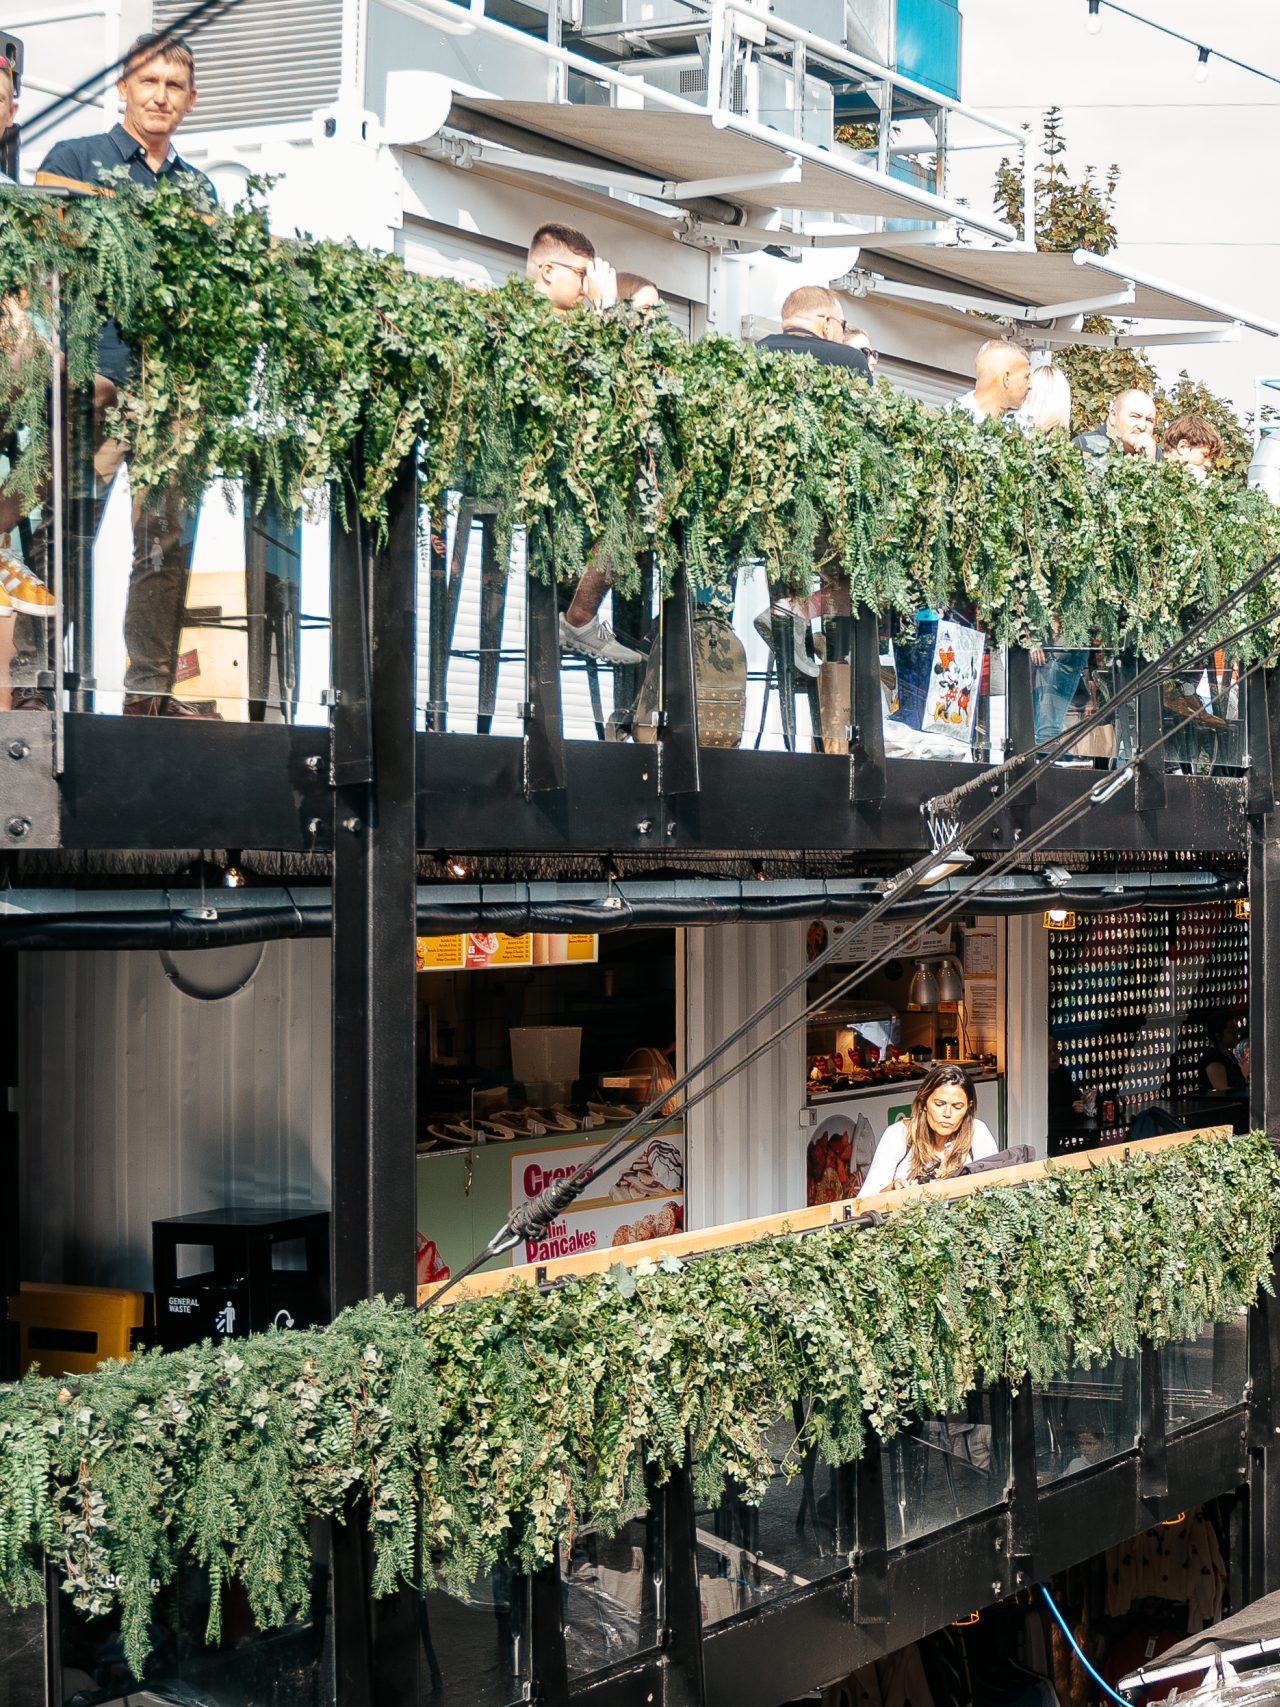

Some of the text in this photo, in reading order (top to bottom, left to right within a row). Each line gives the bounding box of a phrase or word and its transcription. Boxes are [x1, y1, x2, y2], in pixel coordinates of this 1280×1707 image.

[523, 1163, 594, 1197] Cre
[525, 1229, 596, 1263] Pancakes
[168, 1297, 200, 1307] GENERAL
[169, 1305, 192, 1314] WASTE
